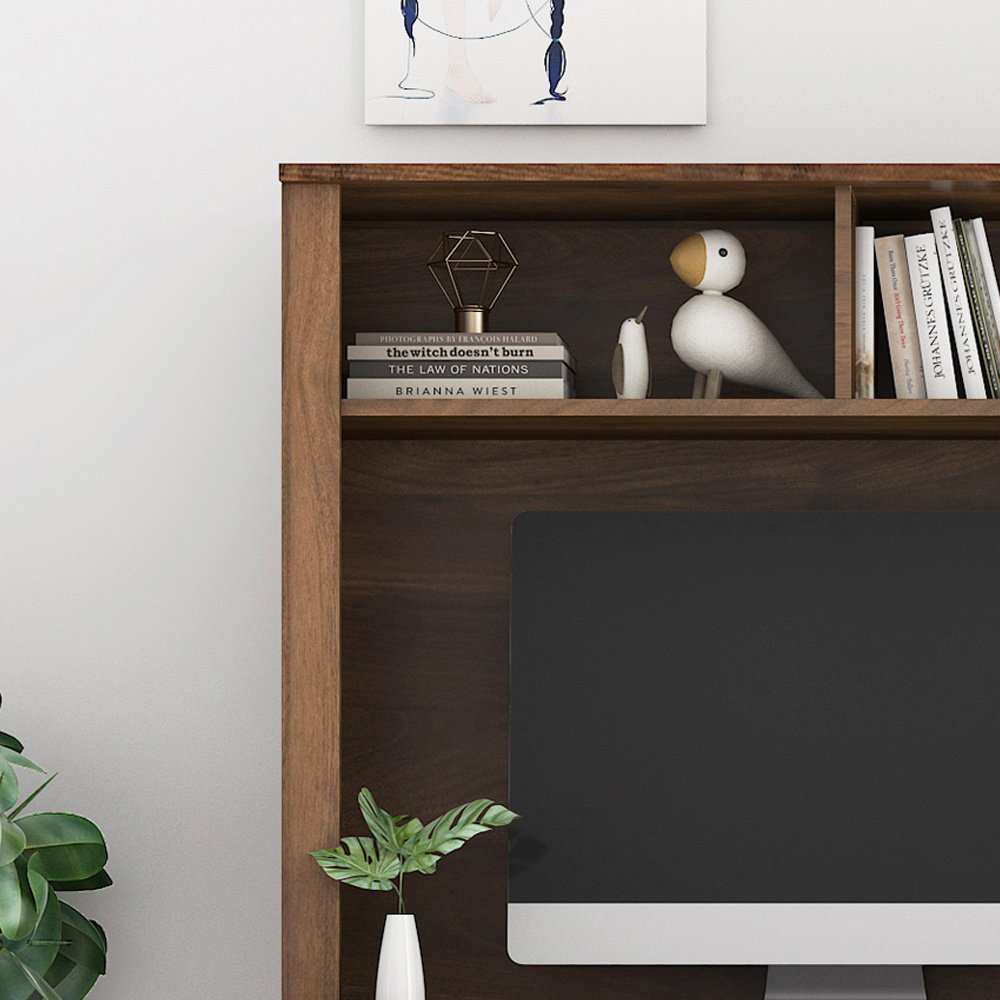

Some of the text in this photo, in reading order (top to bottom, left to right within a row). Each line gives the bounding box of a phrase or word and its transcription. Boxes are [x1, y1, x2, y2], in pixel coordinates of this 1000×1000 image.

[387, 347, 534, 357] the witch doesn't burn
[389, 365, 528, 374] THE LAW OF NATIONS
[396, 387, 517, 395] BRIANNA WIEST
